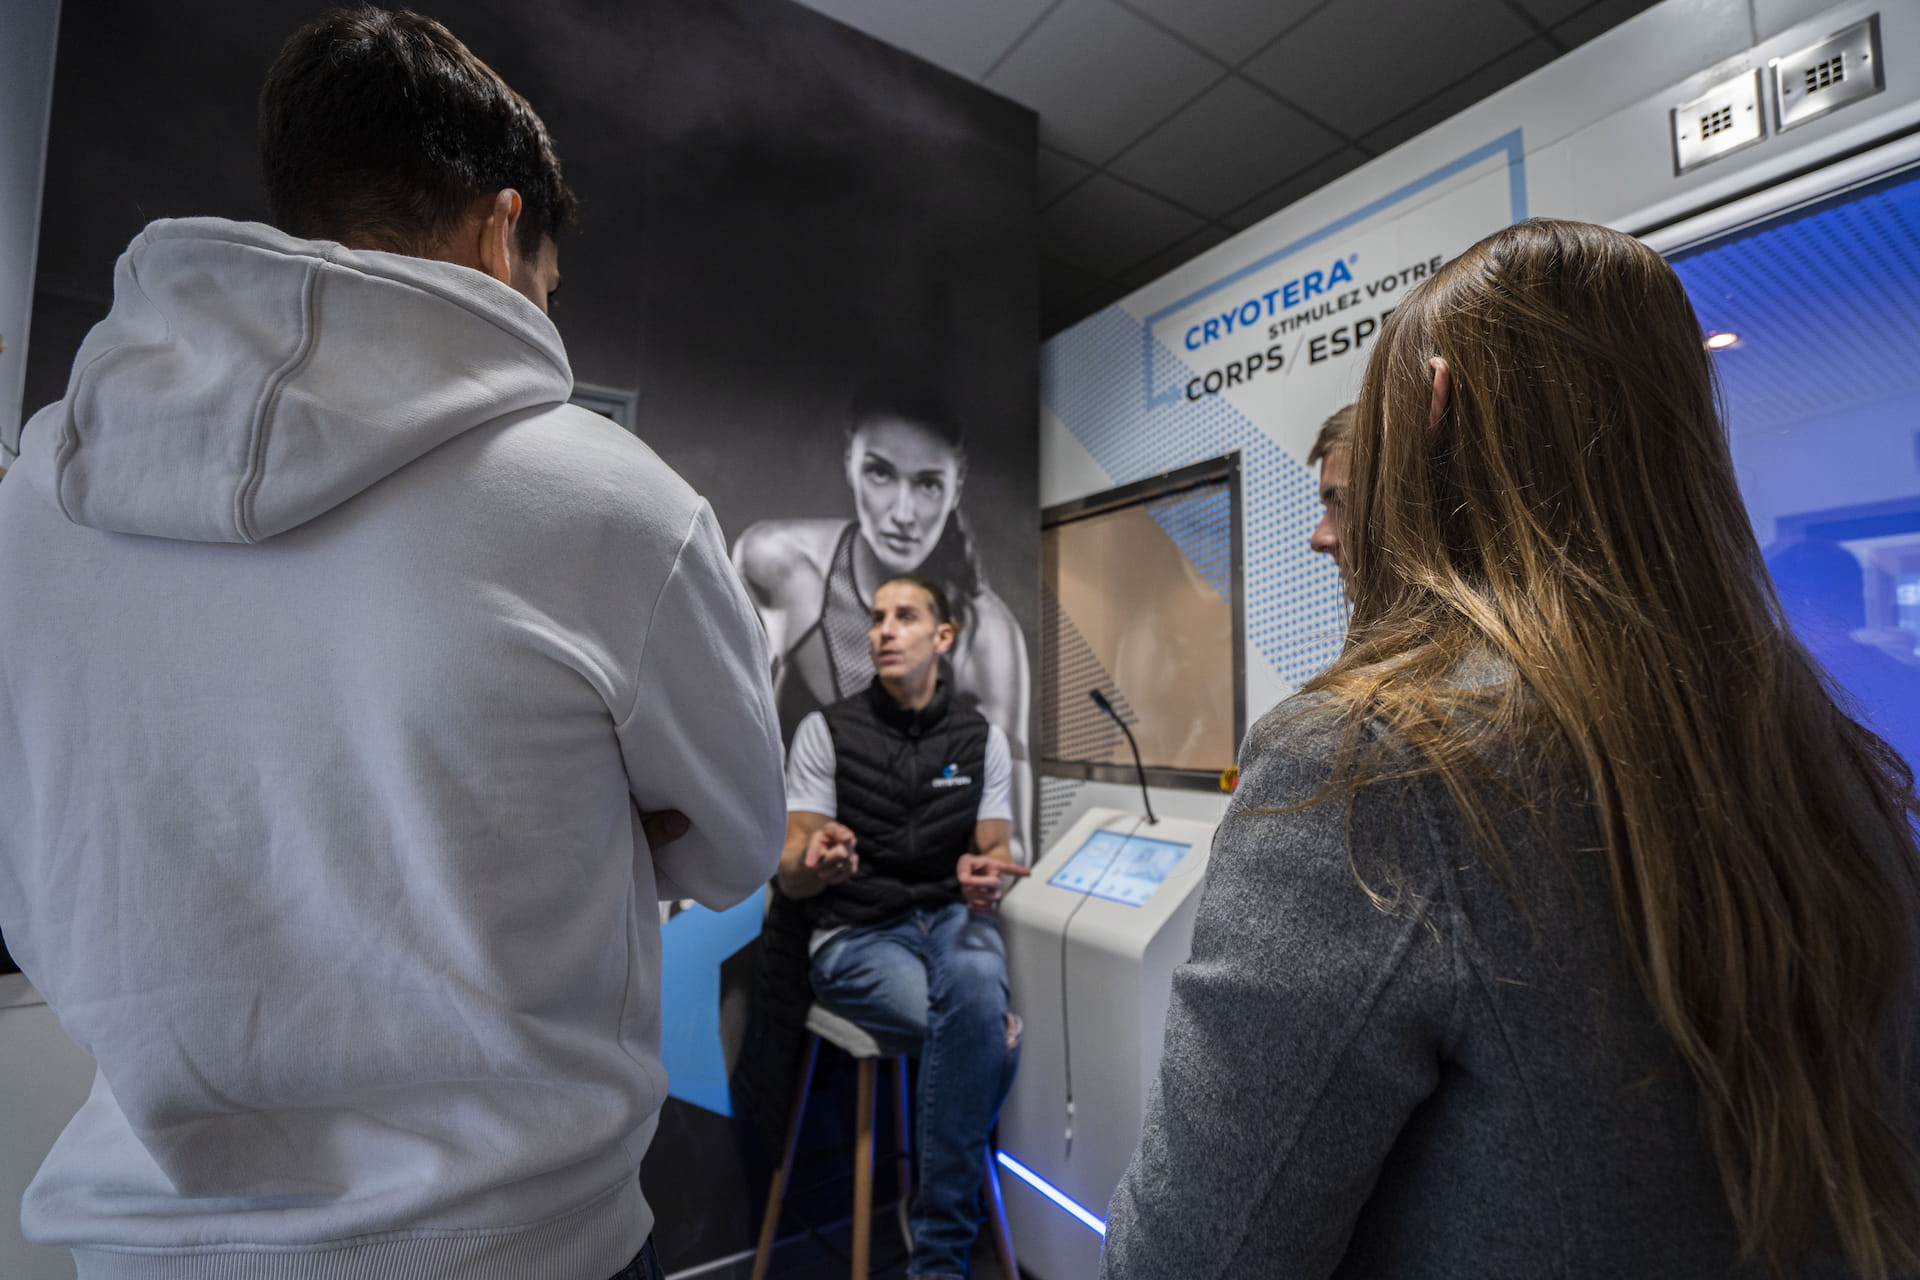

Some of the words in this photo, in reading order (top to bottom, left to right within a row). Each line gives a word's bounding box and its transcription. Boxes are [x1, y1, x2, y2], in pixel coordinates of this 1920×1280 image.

[1267, 289, 1361, 339] STIMULEZ
[1366, 255, 1442, 297] VOTRE
[1185, 346, 1283, 401] CORPS
[1308, 307, 1396, 366] ESP
